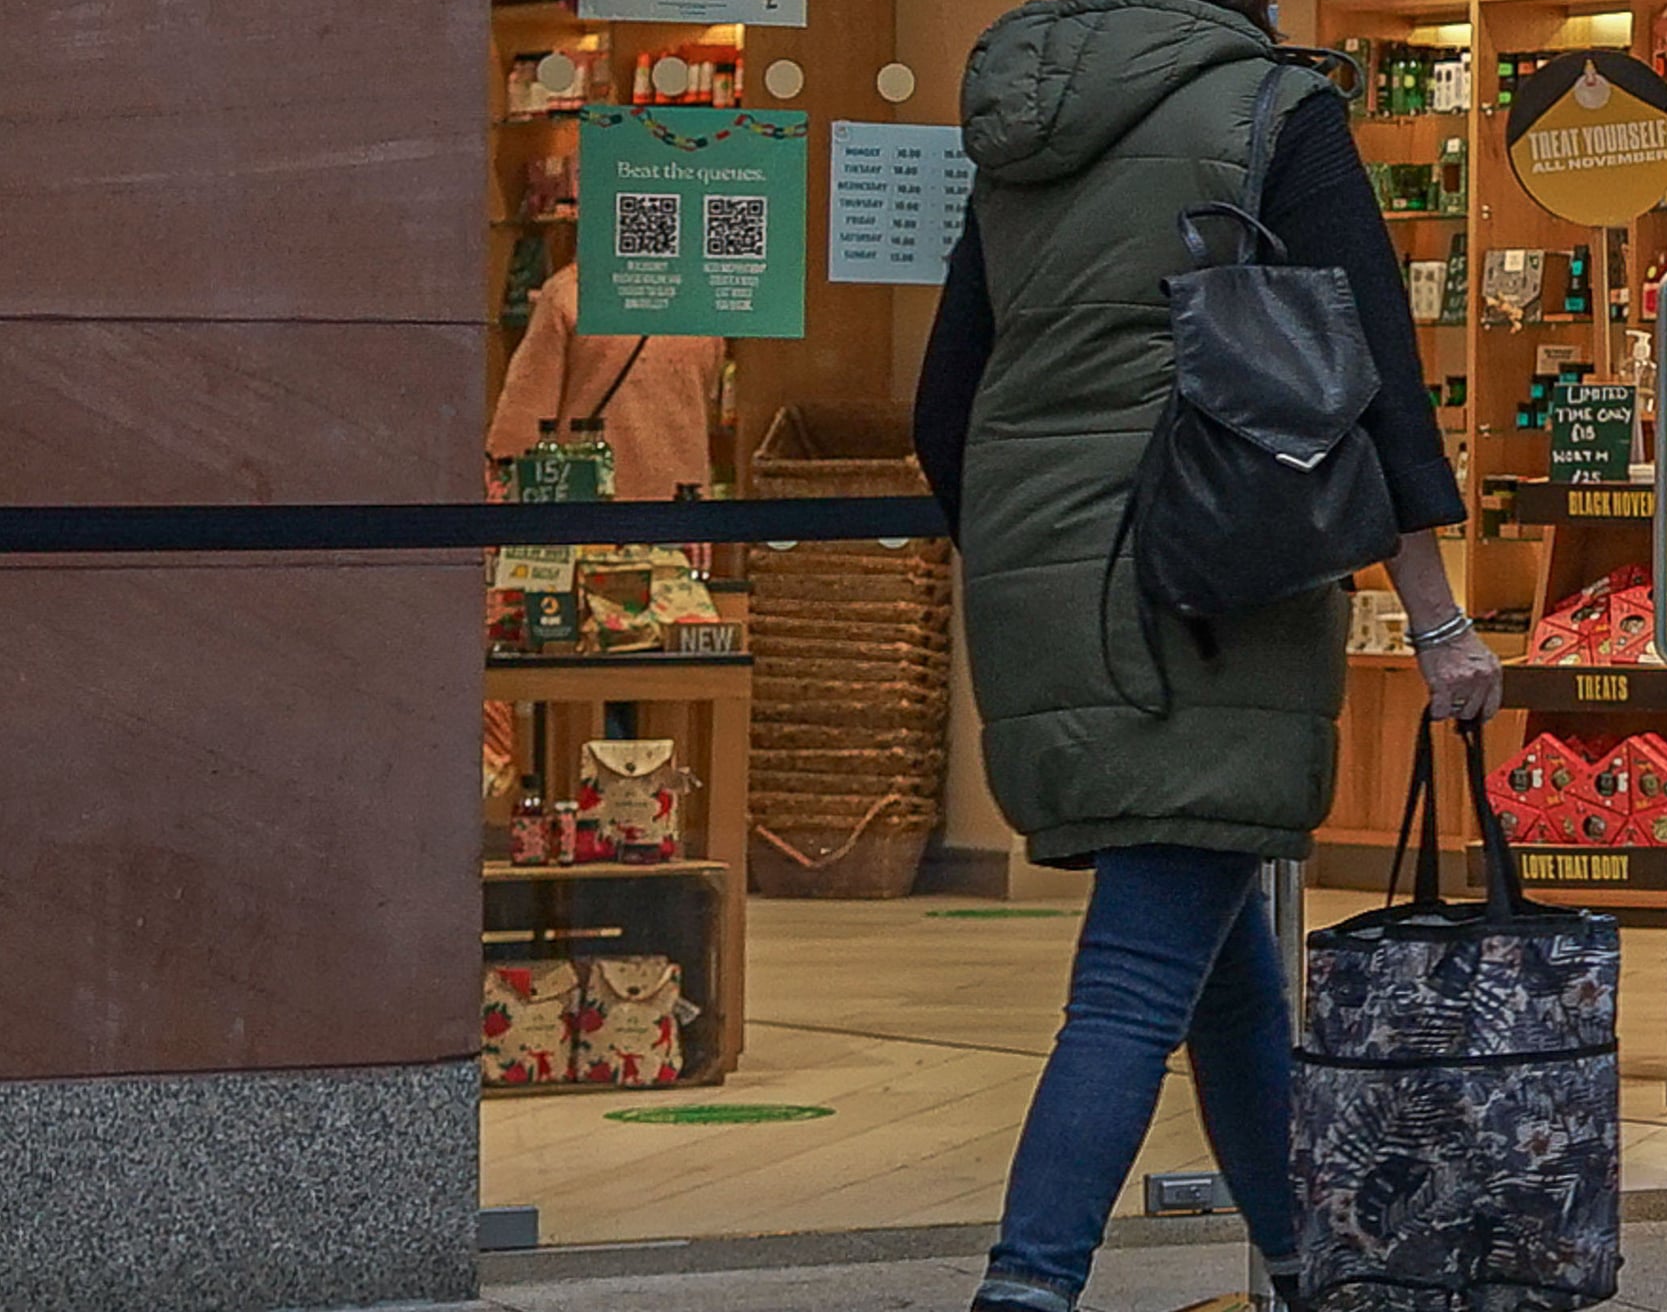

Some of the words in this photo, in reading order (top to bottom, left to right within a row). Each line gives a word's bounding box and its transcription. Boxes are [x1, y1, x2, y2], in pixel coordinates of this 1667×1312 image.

[1528, 128, 1581, 161] TREAT
[1581, 118, 1667, 156] YOURSELF
[616, 160, 661, 179] Beat
[663, 161, 696, 181] the
[697, 166, 767, 185] queues.
[1531, 160, 1566, 174] ALL
[1555, 407, 1594, 424] TIME
[1596, 407, 1633, 425] ONLY
[1552, 449, 1610, 464] WORTH
[1567, 490, 1611, 517] BLACK
[679, 625, 736, 653] NEW
[1575, 674, 1629, 701] TREATS
[1521, 854, 1556, 880] LOVE
[1556, 854, 1589, 880] THAT
[1591, 854, 1630, 880] BODY
